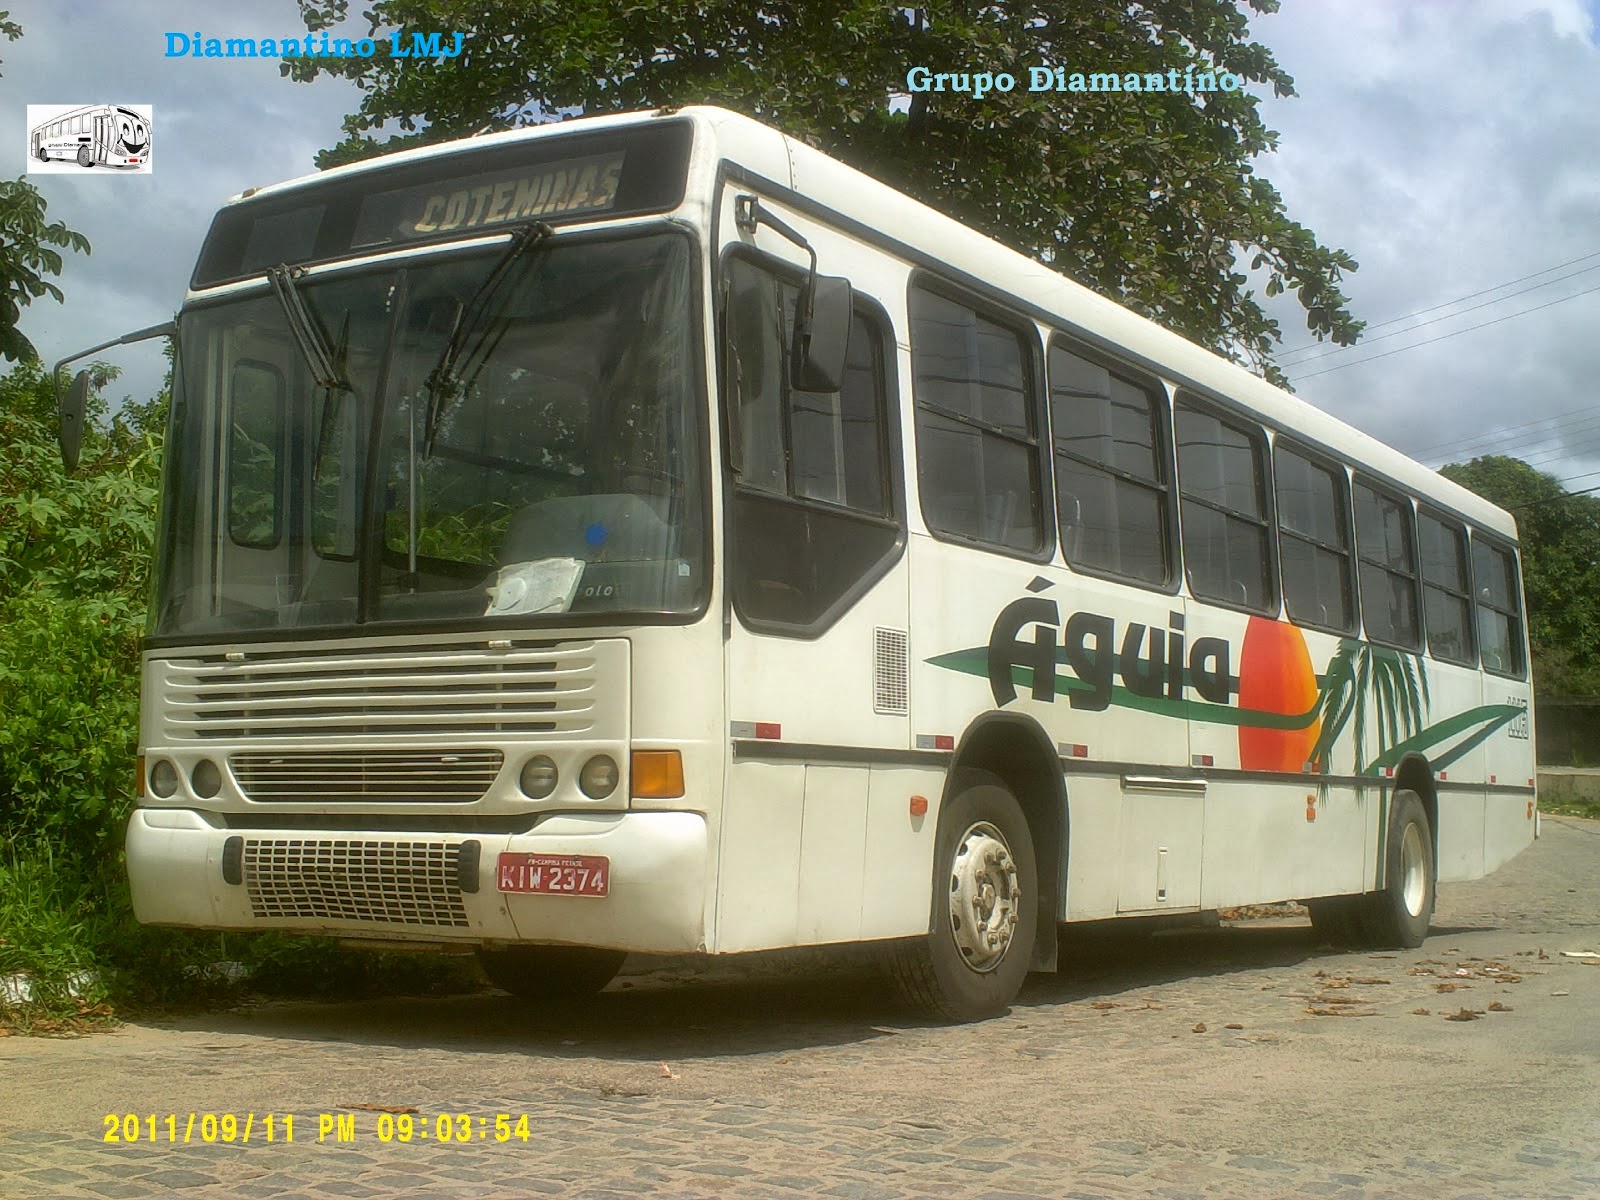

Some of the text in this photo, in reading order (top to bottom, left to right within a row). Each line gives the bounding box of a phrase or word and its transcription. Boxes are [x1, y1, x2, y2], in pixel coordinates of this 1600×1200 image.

[413, 159, 625, 232] COTEMINAS
[987, 575, 1231, 712] Águia
[548, 867, 604, 892] 2374
